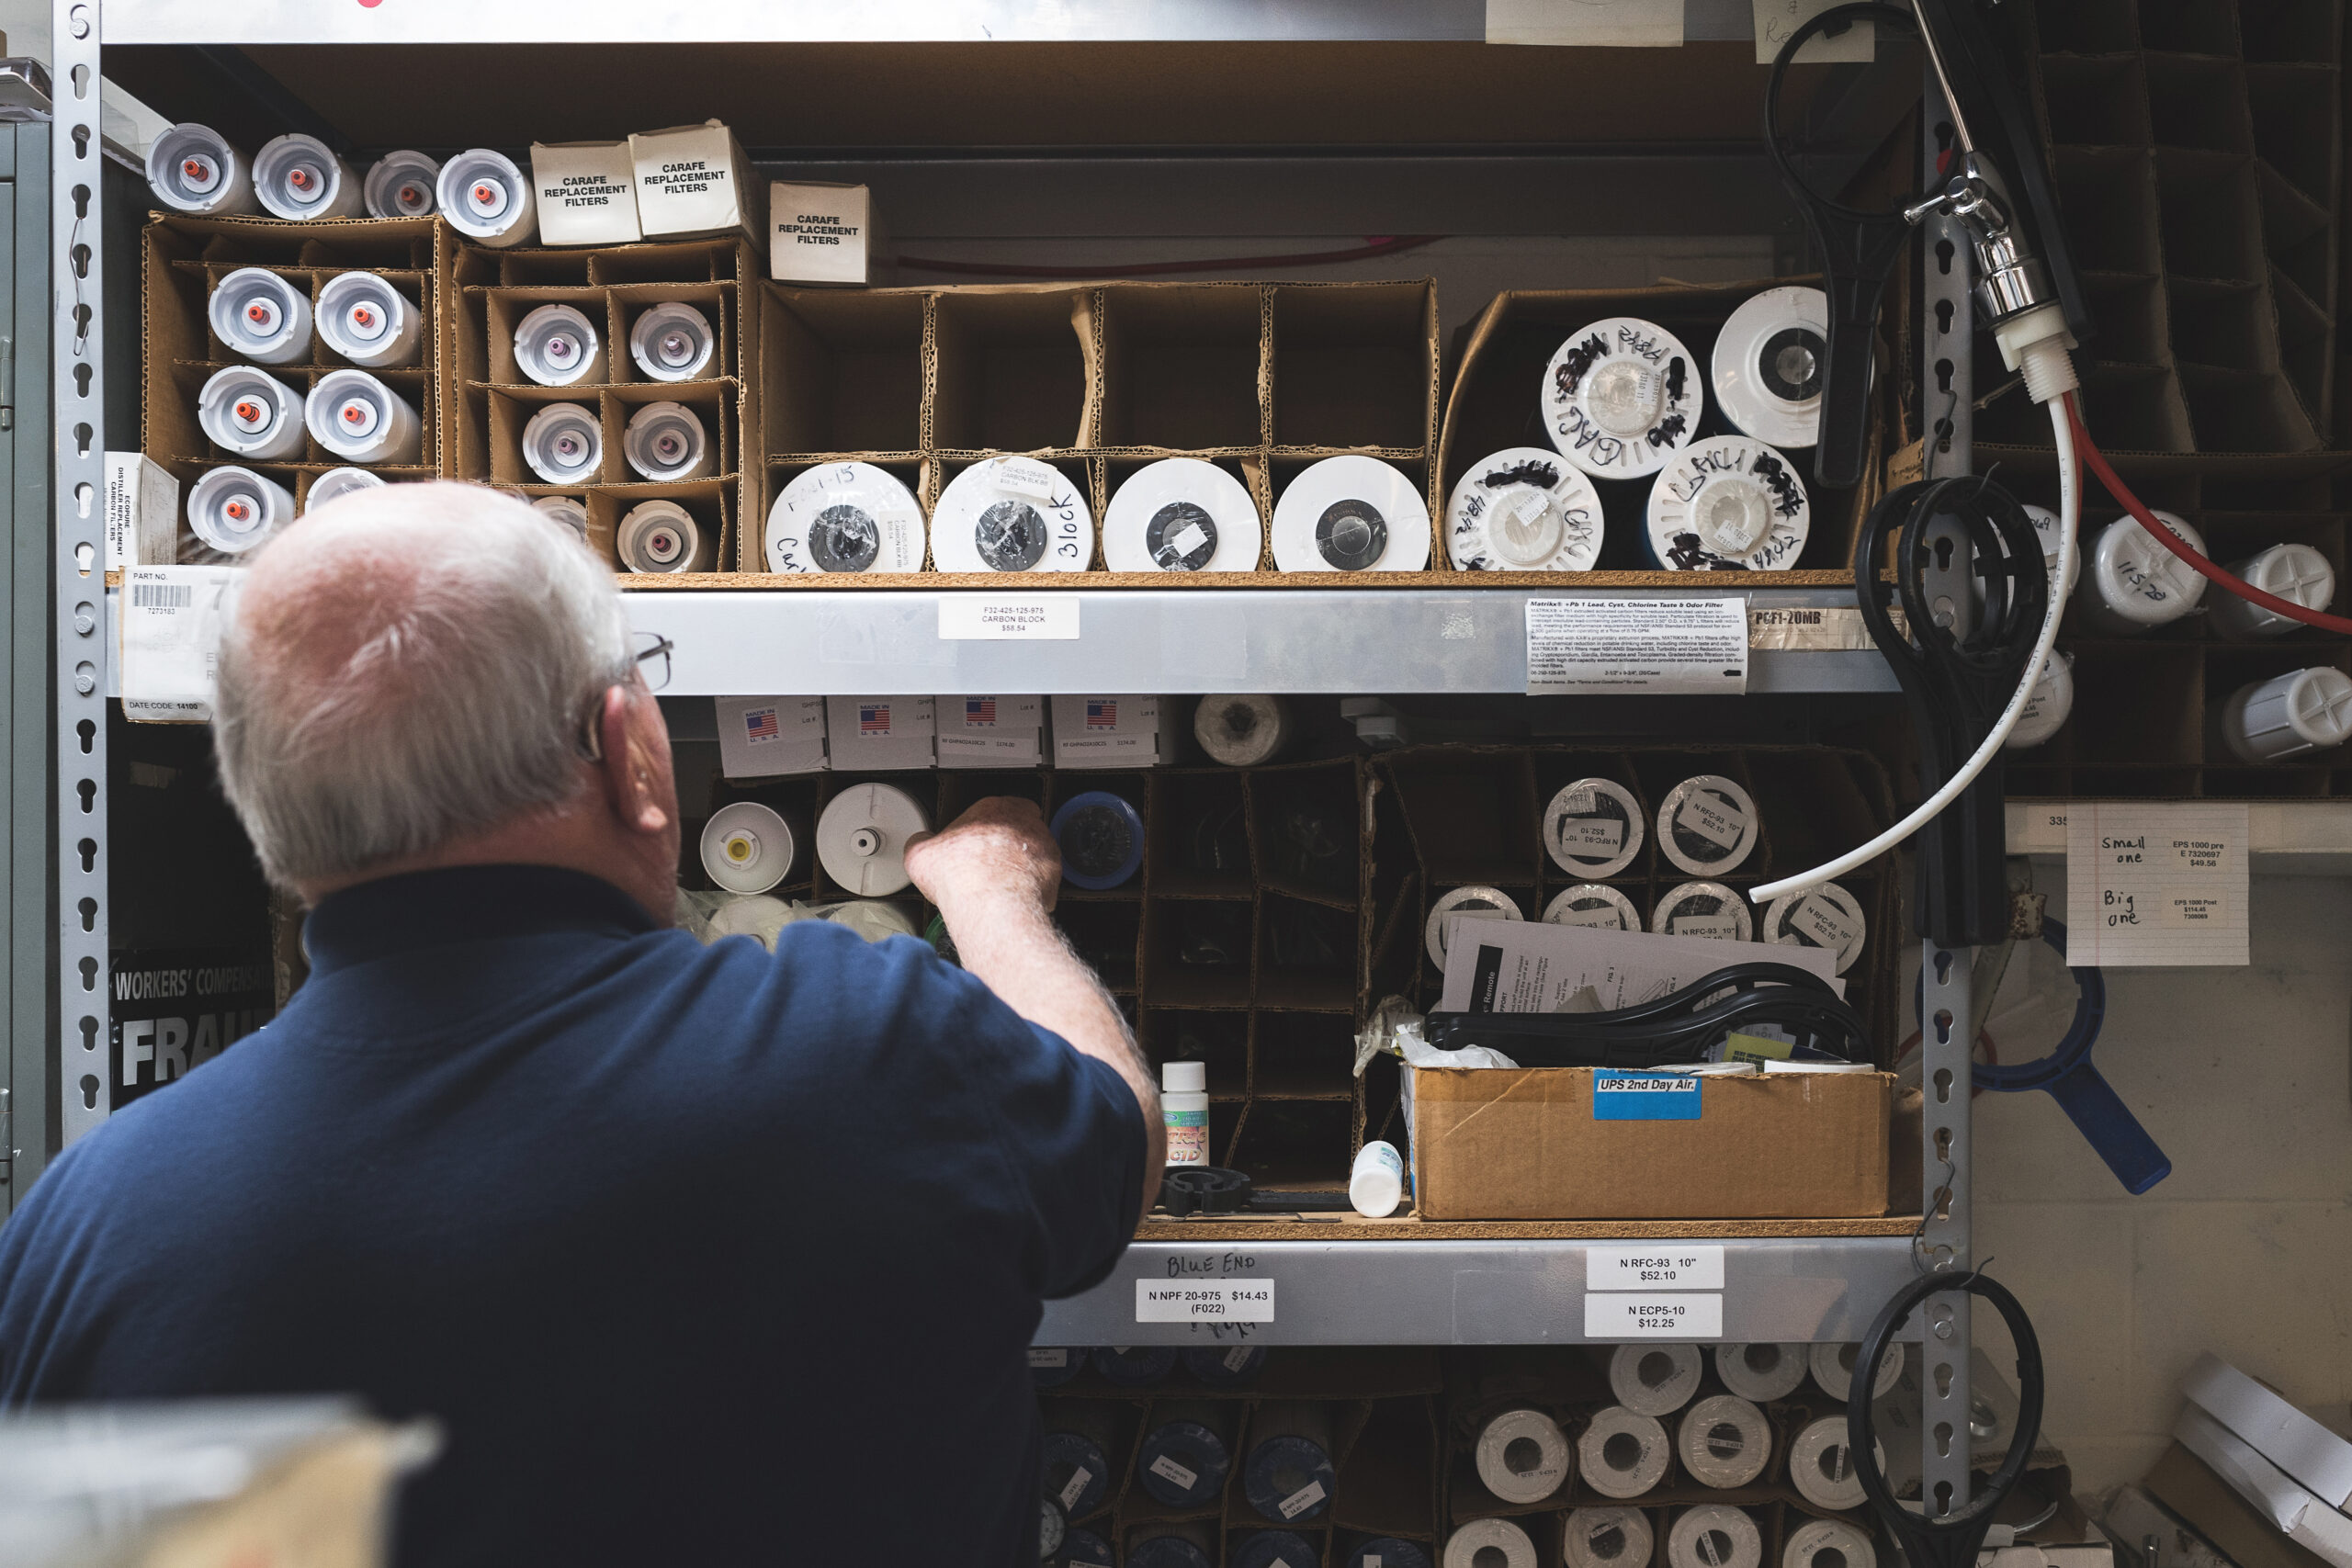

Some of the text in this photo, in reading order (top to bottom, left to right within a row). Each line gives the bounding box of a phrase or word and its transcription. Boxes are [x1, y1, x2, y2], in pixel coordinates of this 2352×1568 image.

[662, 162, 706, 173] CARAFE
[563, 175, 606, 186] CARAFE
[645, 171, 725, 185] REPLACEMENT
[545, 186, 627, 198] REPLACEMENT
[665, 183, 707, 195] FILTERS
[565, 197, 608, 207] FILTERS
[797, 215, 840, 225] CARAFE
[779, 224, 858, 236] REPLACEMENT
[797, 235, 840, 245] FILTERS
[1701, 807, 1724, 825] RFC-93
[1728, 821, 1740, 831] 10"
[1581, 828, 1605, 836] $52.10
[1702, 818, 1724, 834] $52.10
[2102, 836, 2144, 849] Small
[2117, 852, 2143, 863] one
[2190, 859, 2216, 867] $49.56
[2104, 890, 2133, 912] Big
[1813, 909, 1838, 931] RFC-93
[1840, 930, 1852, 940] 10"
[2109, 912, 2140, 926] one
[1814, 922, 1837, 941] $52.10
[116, 969, 191, 1000] WORKERS'
[1485, 971, 1496, 1003] Remote
[1600, 1079, 1694, 1091] UPS 2nd Day Air.
[1167, 1253, 1255, 1278] BLUE END
[1631, 1258, 1670, 1268] RFC-93
[1679, 1258, 1696, 1267] 10"
[1640, 1271, 1676, 1281] $52.10
[1149, 1292, 1268, 1302] N NPF 20-975 $14.43
[1191, 1304, 1225, 1314] (F022)
[1628, 1306, 1685, 1314] N ECP5-10
[1639, 1319, 1674, 1328] $12.25
